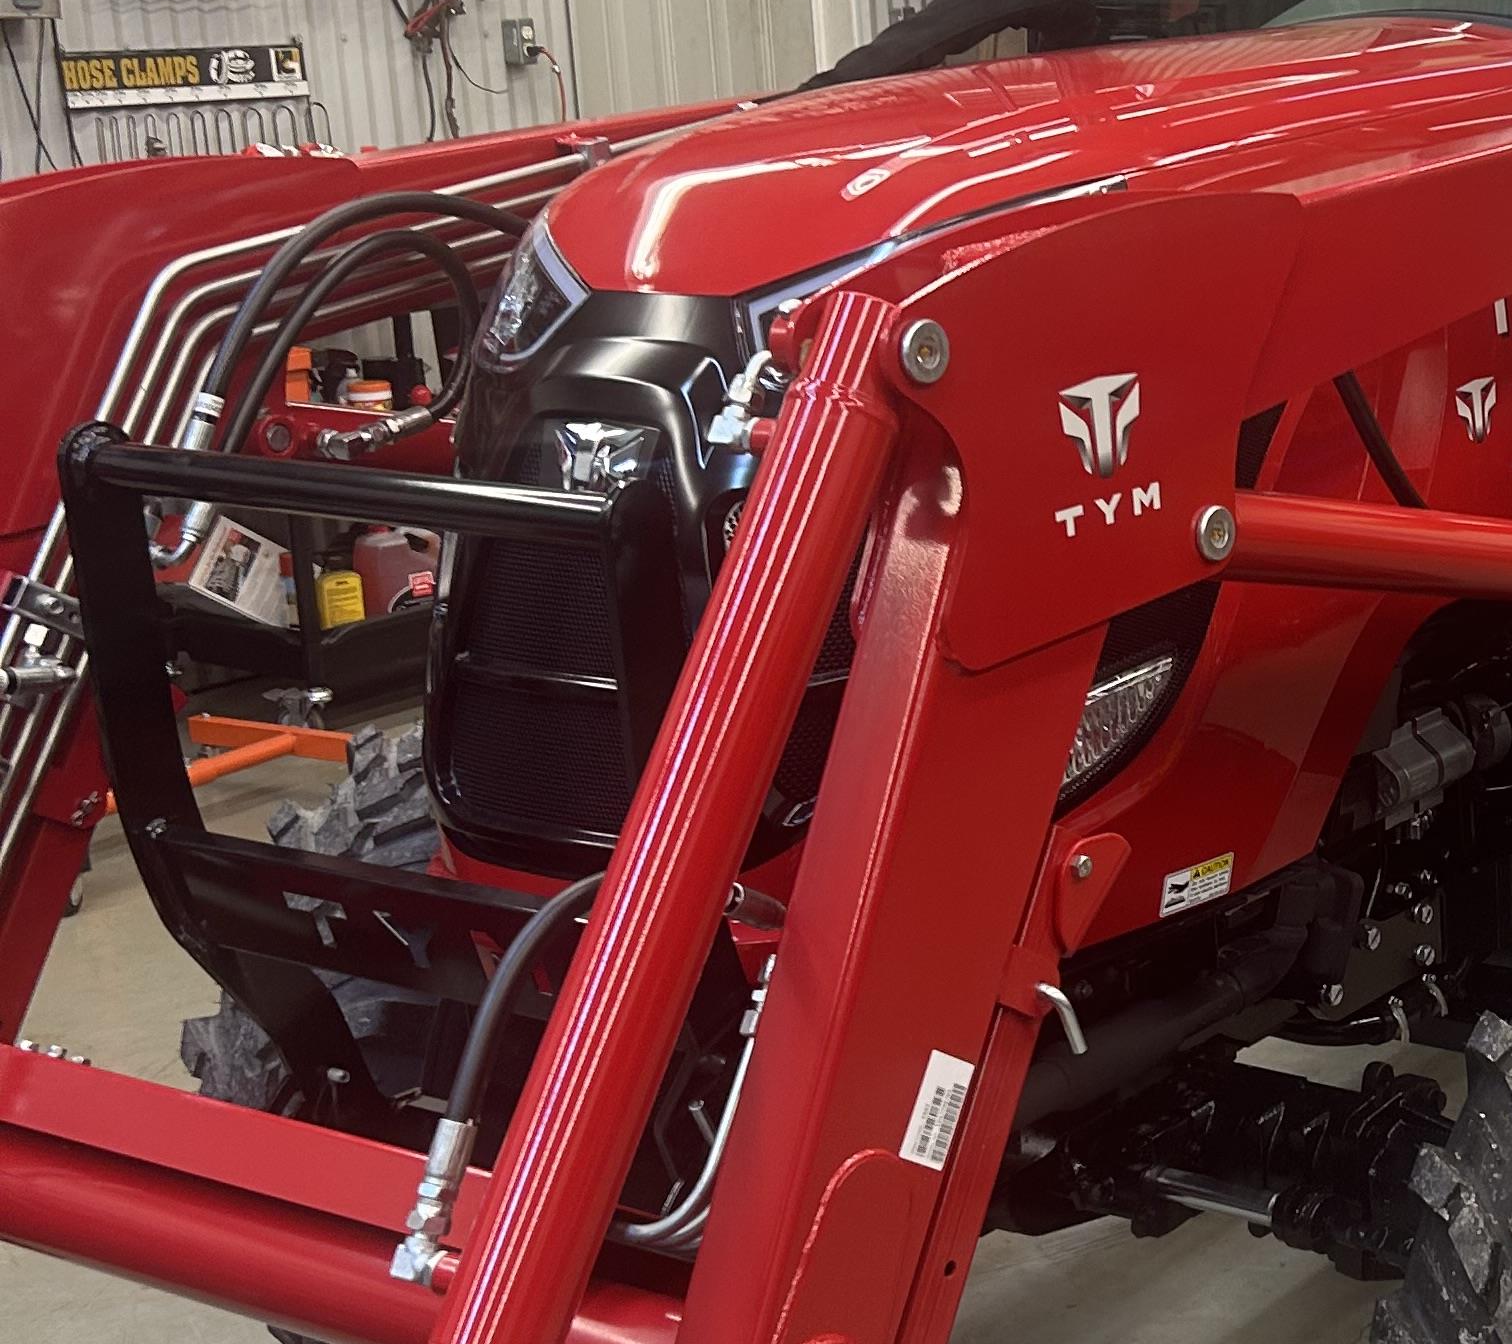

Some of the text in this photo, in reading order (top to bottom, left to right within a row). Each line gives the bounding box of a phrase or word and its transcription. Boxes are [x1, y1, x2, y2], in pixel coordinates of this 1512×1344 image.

[62, 55, 201, 91] HOSE CLAMPS
[1054, 481, 1162, 538] TYM
